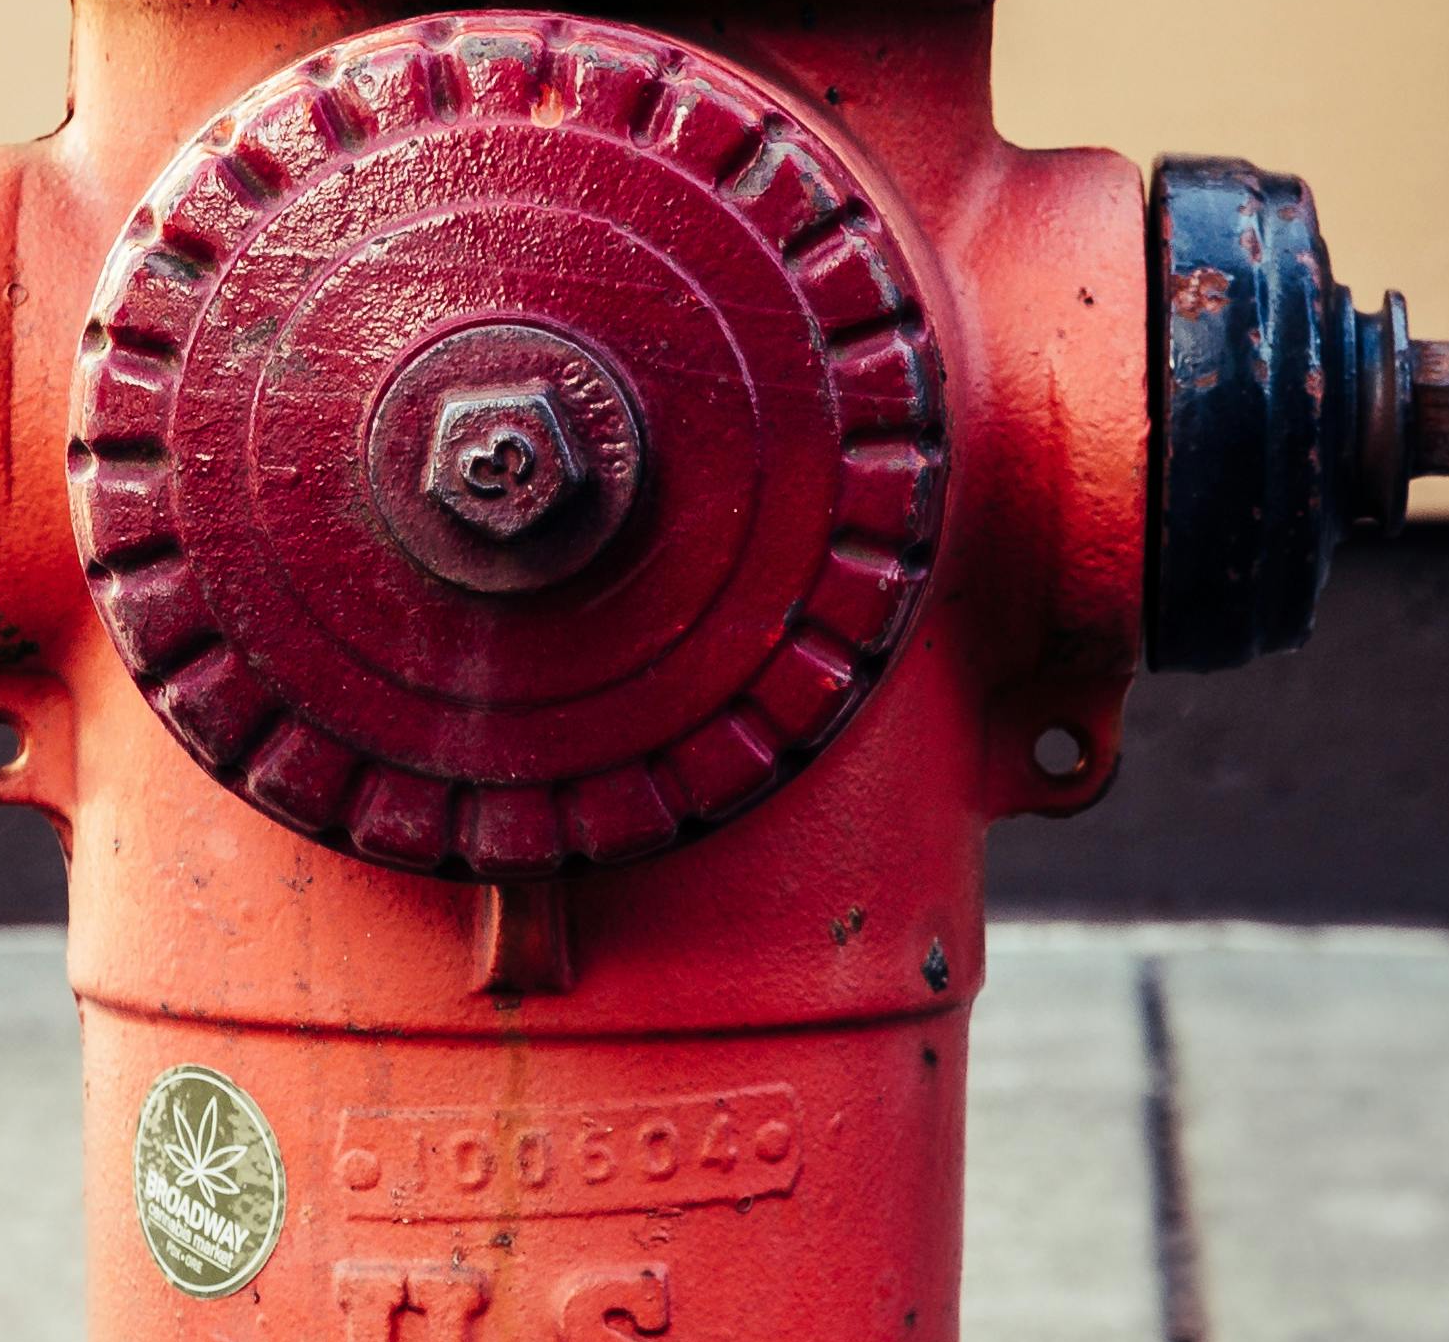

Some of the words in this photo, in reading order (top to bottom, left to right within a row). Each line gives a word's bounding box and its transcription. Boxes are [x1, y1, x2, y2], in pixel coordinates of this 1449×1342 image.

[144, 1167, 250, 1253] BROADWAY
[148, 1201, 192, 1243] cannabis
[192, 1233, 234, 1268] market
